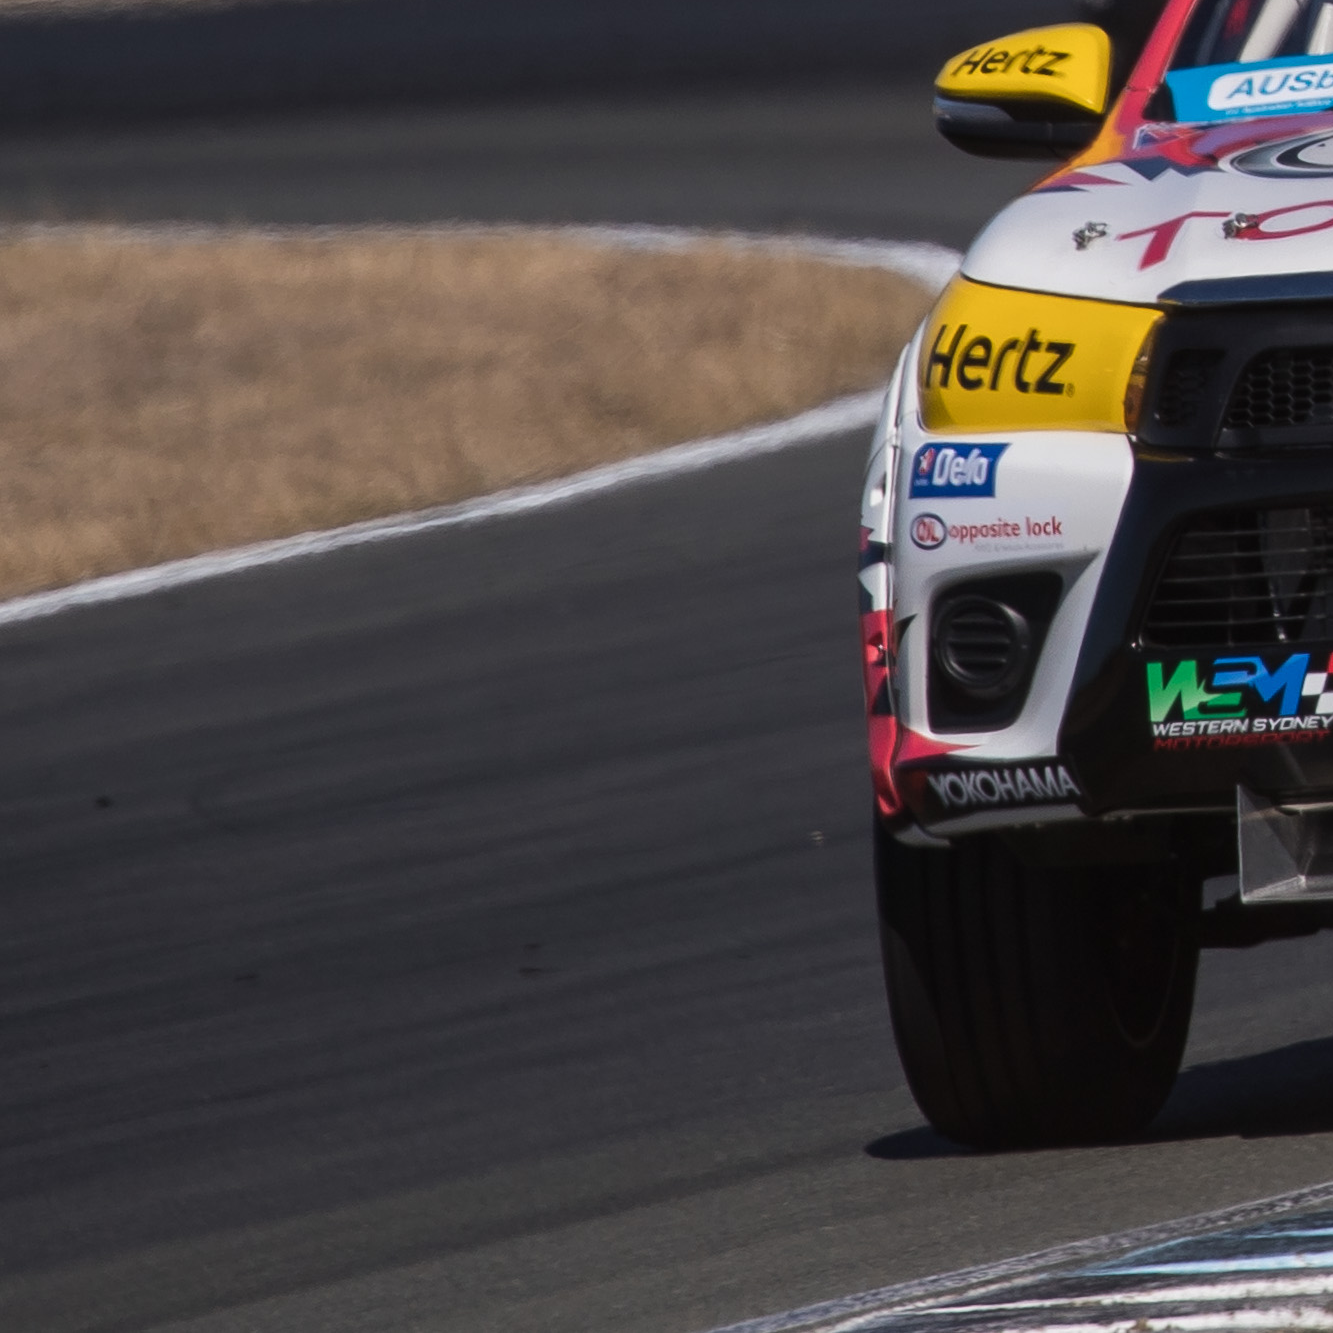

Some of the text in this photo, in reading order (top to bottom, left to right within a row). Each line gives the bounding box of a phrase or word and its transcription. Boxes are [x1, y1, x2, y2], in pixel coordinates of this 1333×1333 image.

[950, 44, 1070, 77] Hertz
[926, 322, 1076, 396] Hertz
[932, 447, 990, 487] Delo
[916, 515, 1063, 544] OL opposite lock
[1152, 717, 1250, 737] WESTERN
[928, 764, 1081, 809] YOKOHAMA
